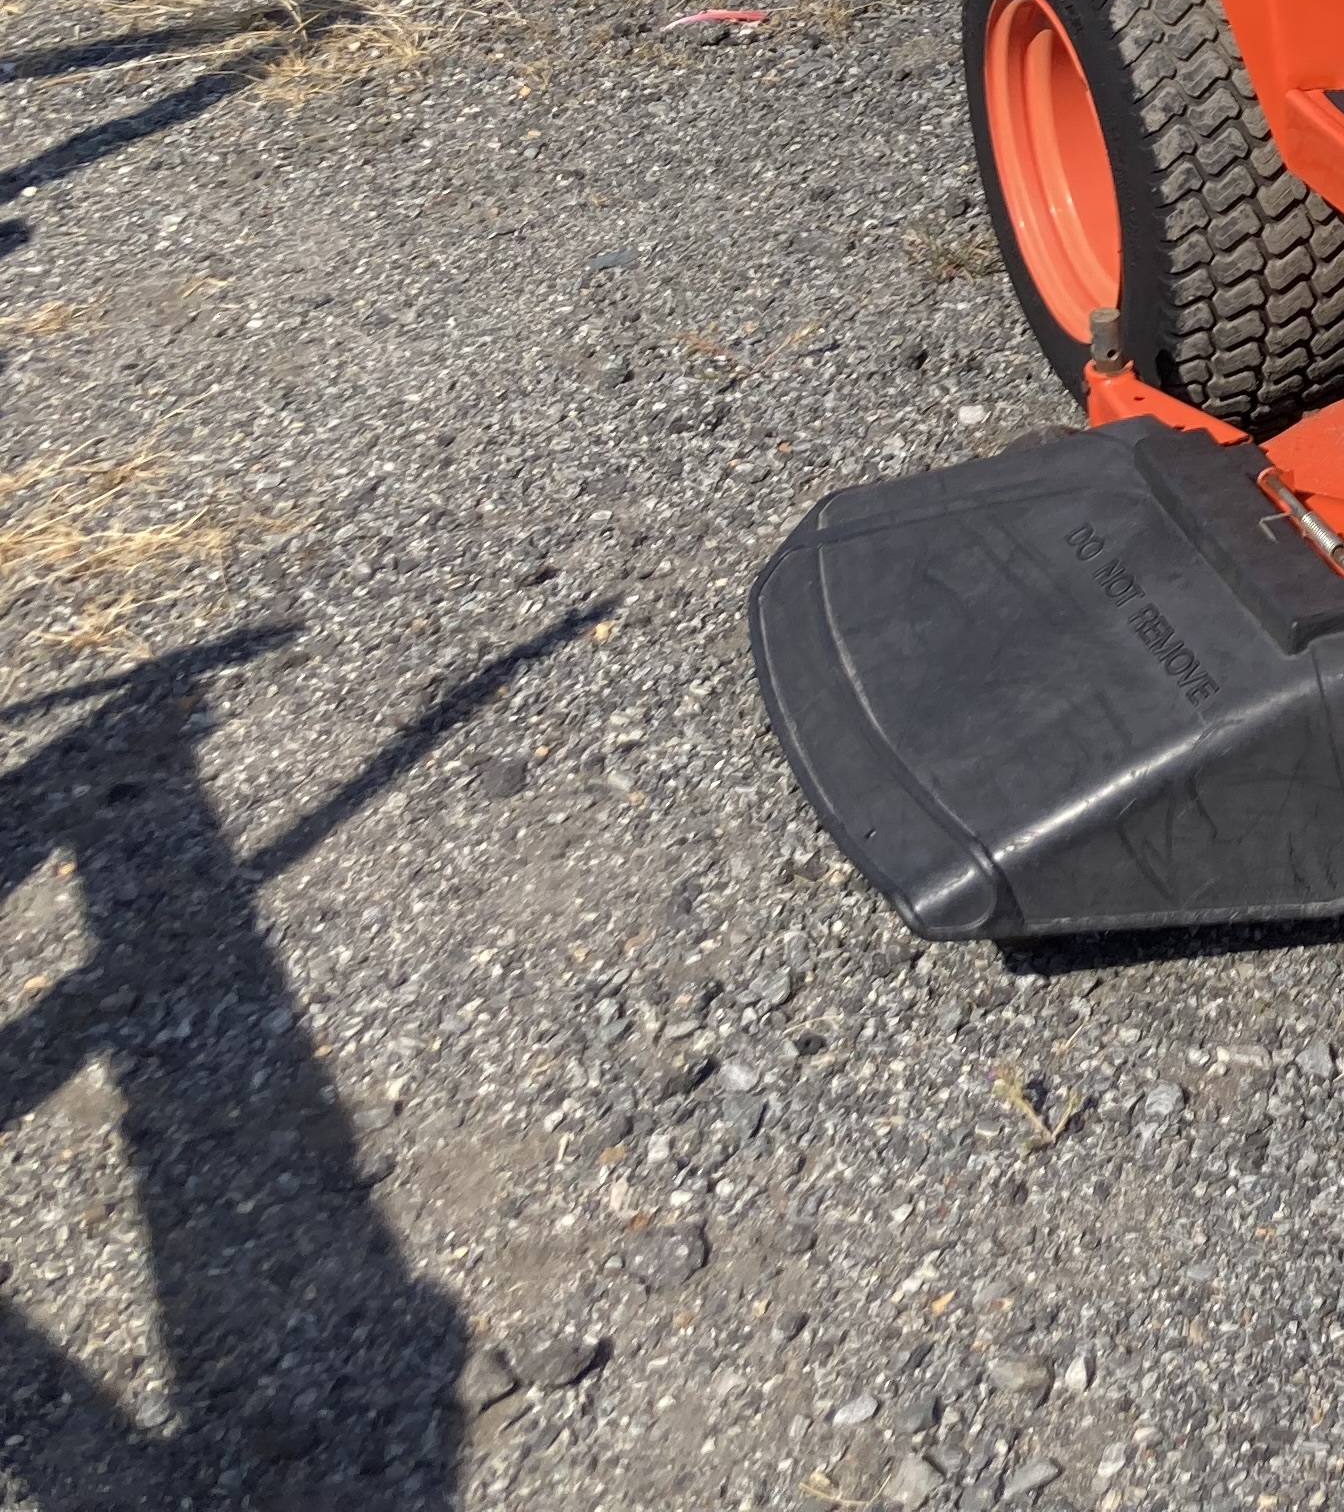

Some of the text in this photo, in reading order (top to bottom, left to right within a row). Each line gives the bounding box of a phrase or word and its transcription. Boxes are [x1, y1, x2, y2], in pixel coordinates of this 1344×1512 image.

[1064, 521, 1222, 708] DO NOT REMOVE
